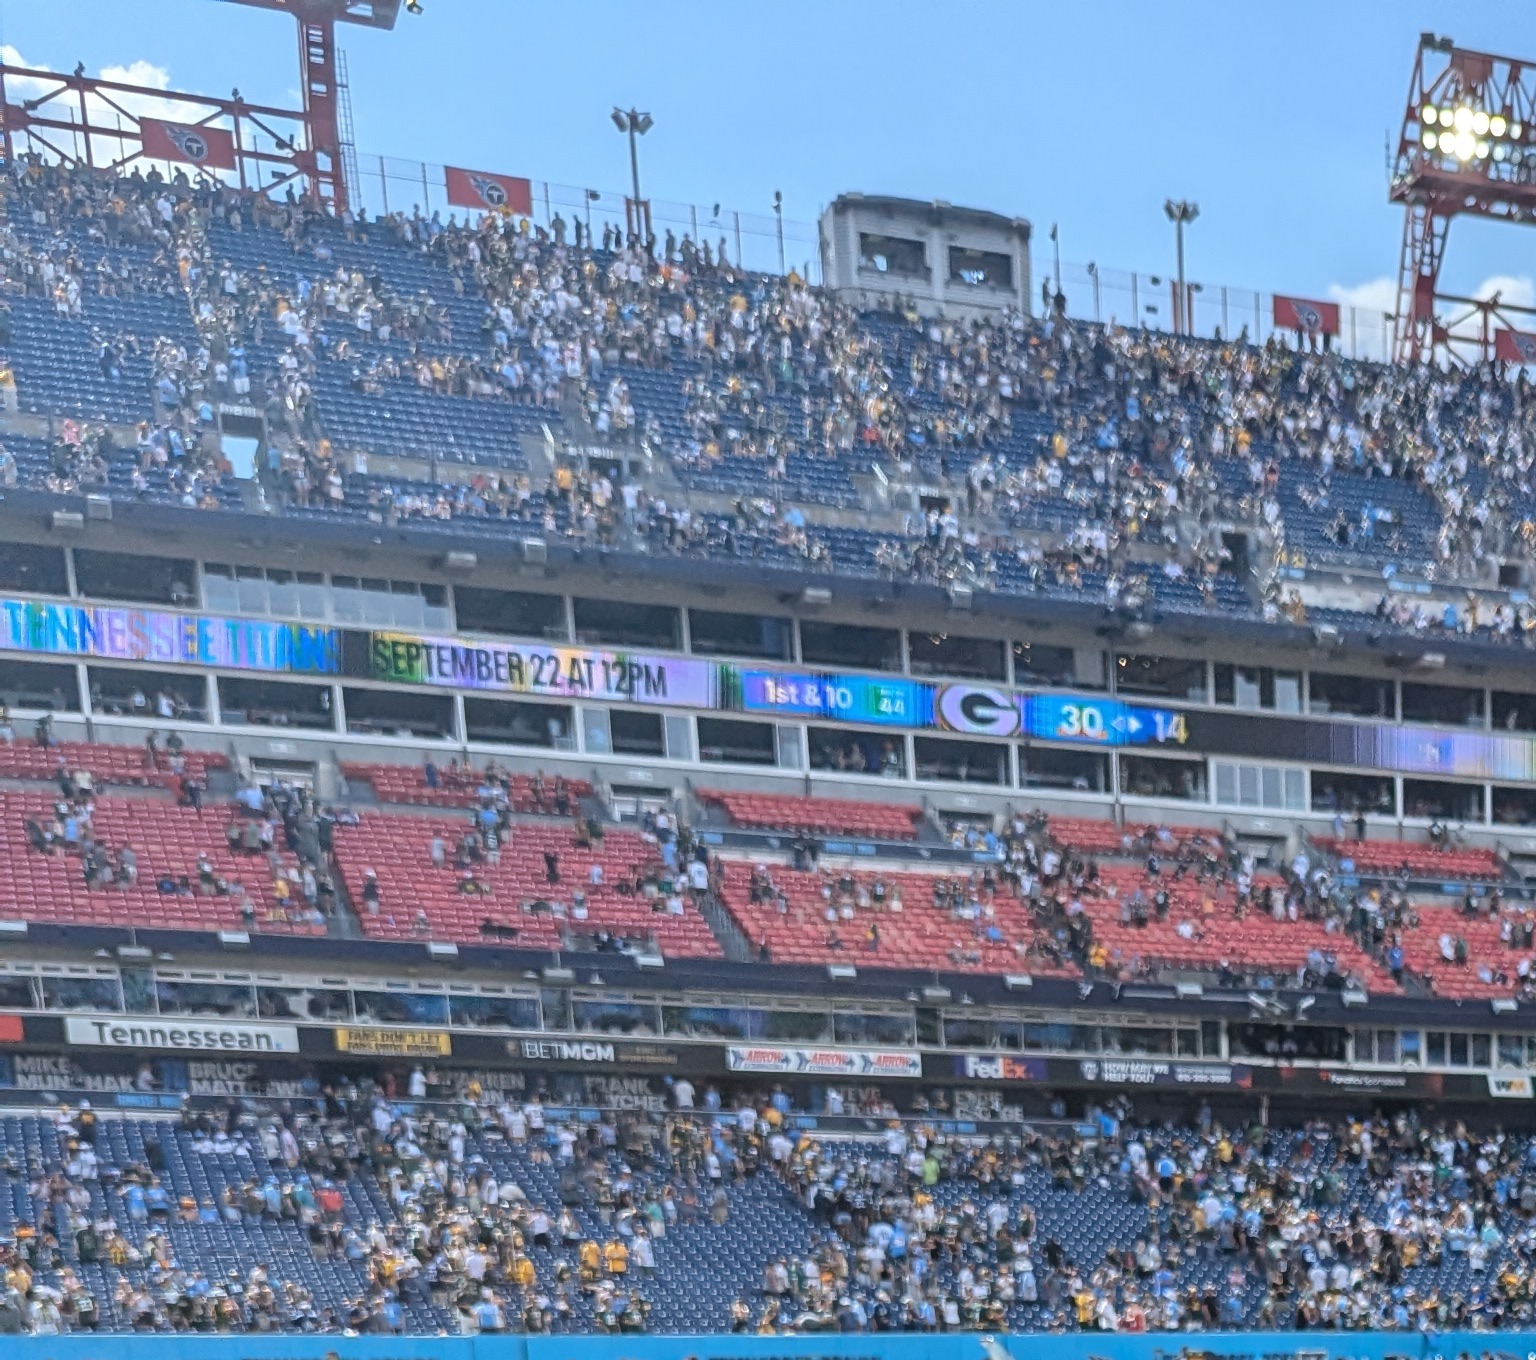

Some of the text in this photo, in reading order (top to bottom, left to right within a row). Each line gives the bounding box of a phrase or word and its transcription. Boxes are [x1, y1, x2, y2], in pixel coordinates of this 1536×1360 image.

[373, 639, 669, 698] SEPTEMBER 22 AT 12PM
[764, 677, 853, 709] 1st & 10
[1062, 704, 1104, 740] 30
[1153, 709, 1188, 744] 14
[522, 1039, 615, 1062] BETMGM
[747, 1049, 781, 1064] ARROW
[811, 1051, 846, 1066] ARROW
[875, 1054, 911, 1068] ARROW
[16, 1073, 135, 1092] MUNHAK
